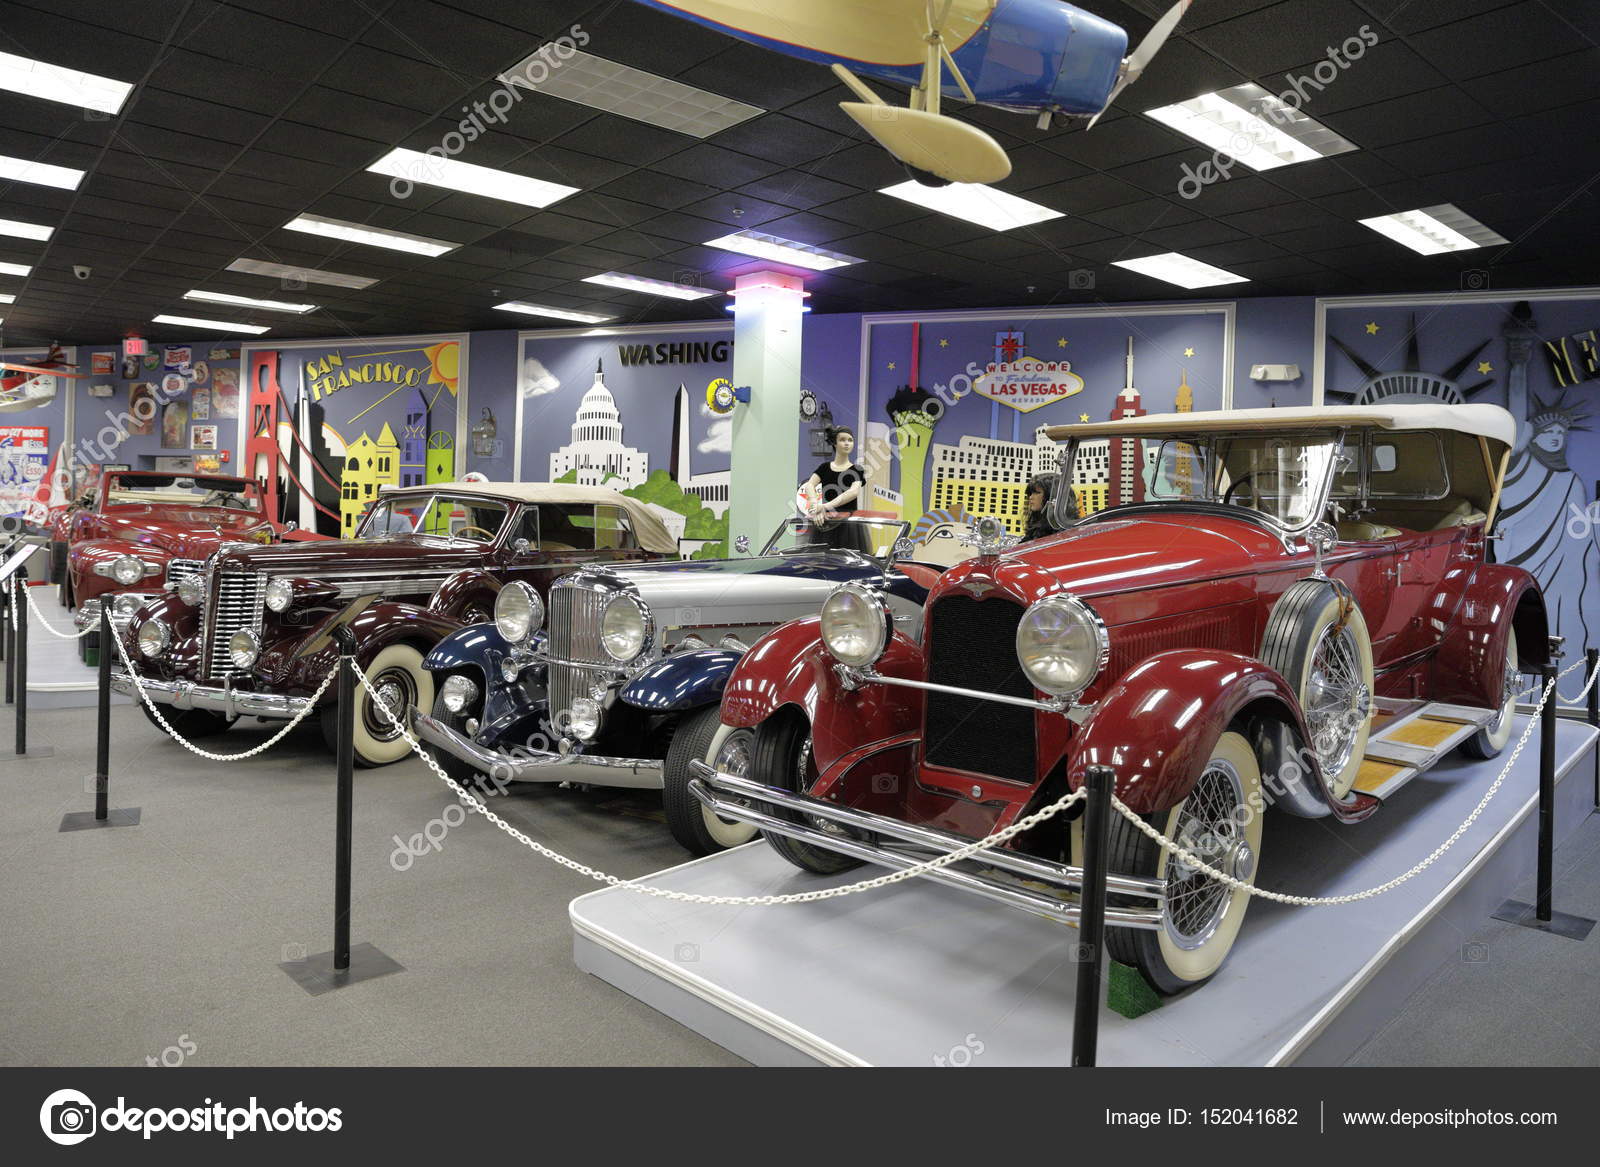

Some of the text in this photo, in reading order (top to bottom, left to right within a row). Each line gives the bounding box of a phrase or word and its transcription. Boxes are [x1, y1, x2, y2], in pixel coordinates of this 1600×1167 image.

[306, 348, 343, 381] SAN
[618, 340, 735, 367] WASHING
[988, 362, 1069, 372] WELCOME
[311, 361, 420, 401] FRANCISCO
[991, 383, 1067, 395] LAS VEGAS
